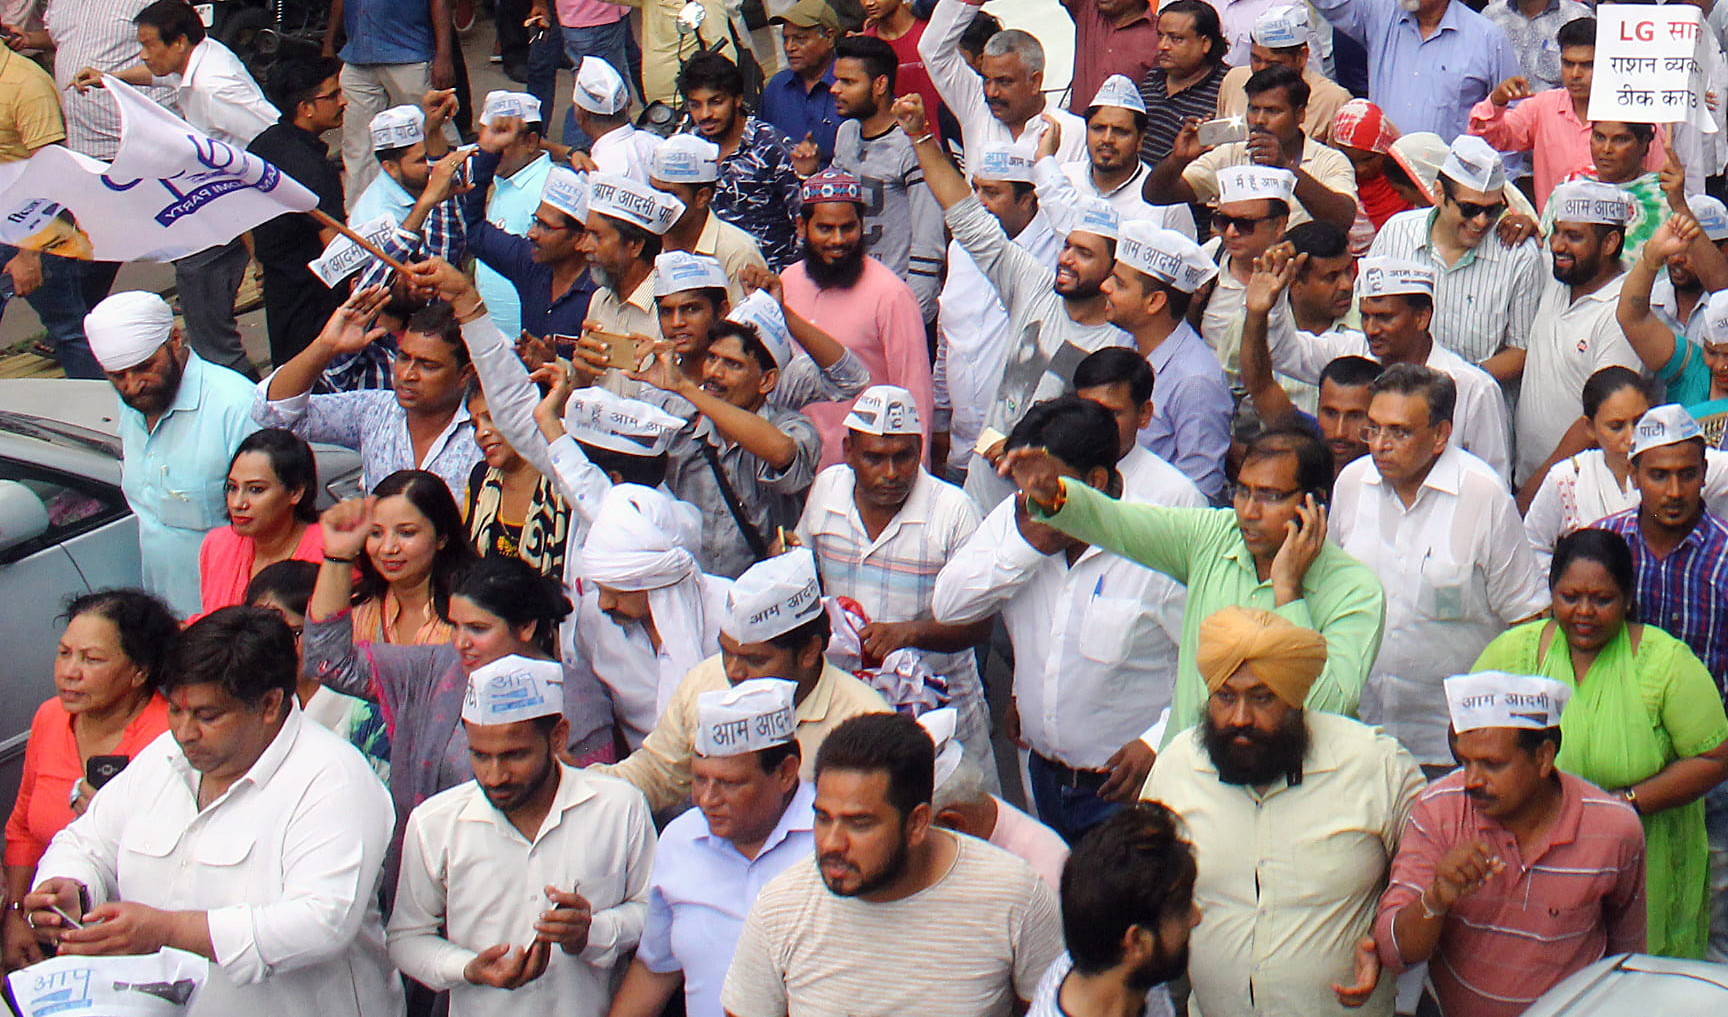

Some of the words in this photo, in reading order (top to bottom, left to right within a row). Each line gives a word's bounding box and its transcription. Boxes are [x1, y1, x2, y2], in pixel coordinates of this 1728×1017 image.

[1620, 20, 1654, 42] LG
[1609, 56, 1658, 74] राशन
[1616, 83, 1655, 107] ठीक
[593, 181, 618, 202] आम
[618, 188, 656, 216] आदमी
[1565, 197, 1591, 215] आम
[1143, 246, 1182, 277] आदमी
[610, 411, 639, 429] आम
[750, 602, 780, 624] आम
[1462, 693, 1495, 708] आम
[1504, 691, 1549, 709] आदमी
[712, 718, 750, 748] आम
